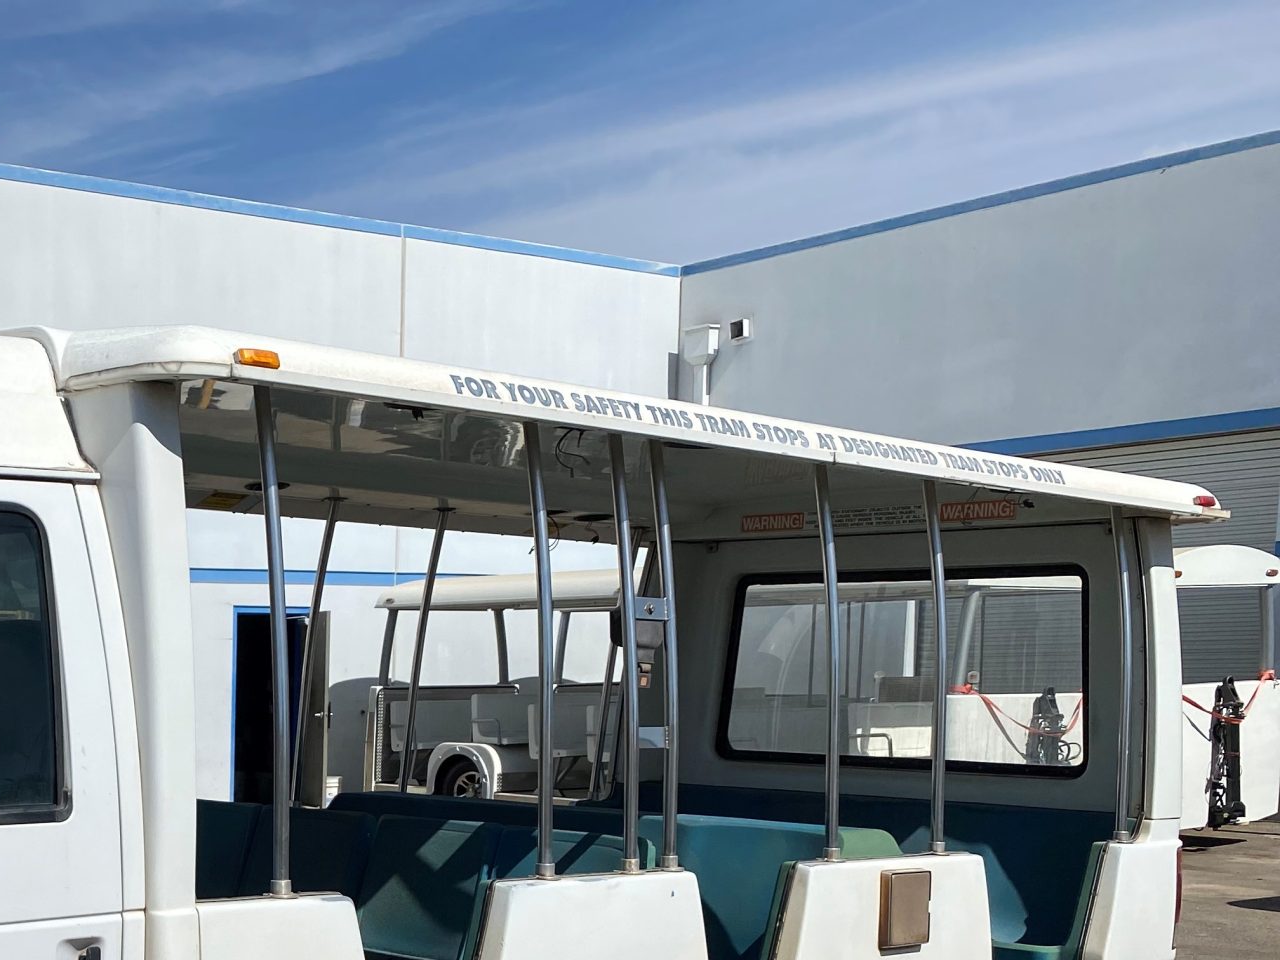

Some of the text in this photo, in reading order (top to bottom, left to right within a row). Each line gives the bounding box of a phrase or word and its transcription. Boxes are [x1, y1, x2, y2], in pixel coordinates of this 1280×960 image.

[449, 373, 1067, 486] FOR YOUR SAFETY THIS TRAM STOPS AT DESIGNATED TRAM STOPS ONLY
[942, 501, 1015, 522] WARNING!
[742, 514, 804, 532] WARNING!
